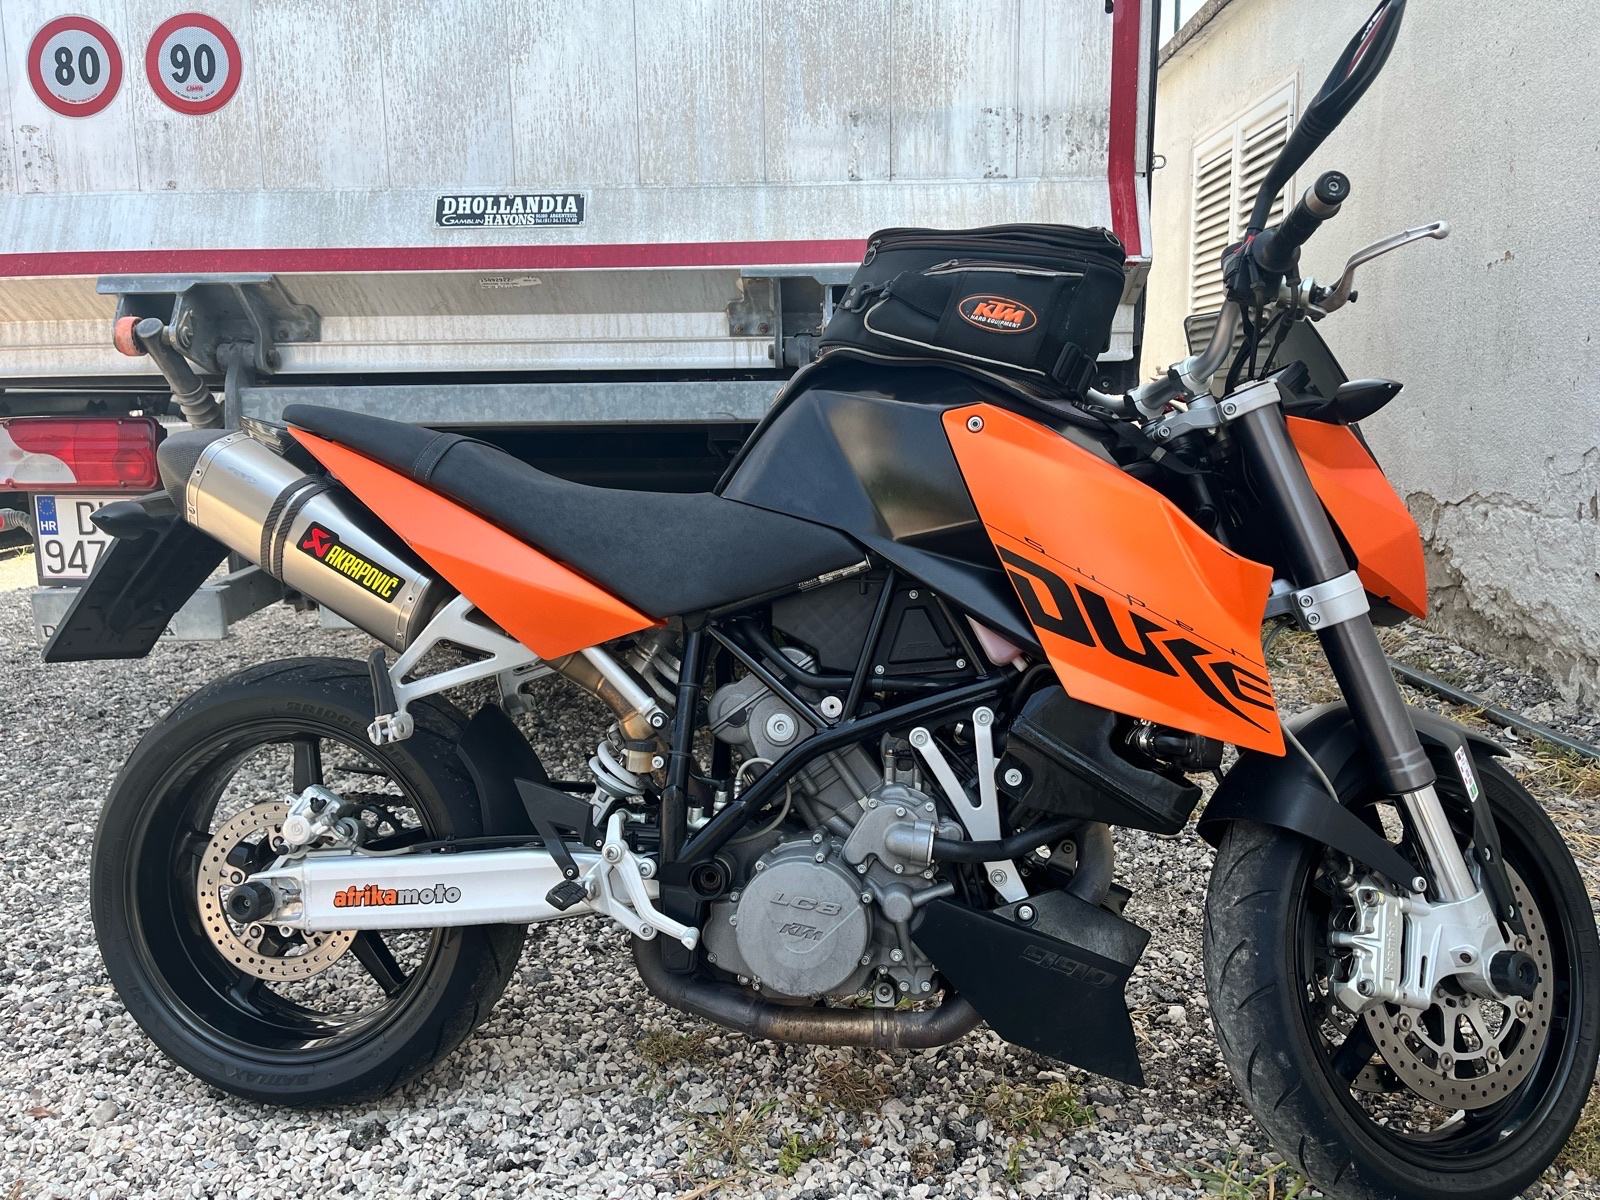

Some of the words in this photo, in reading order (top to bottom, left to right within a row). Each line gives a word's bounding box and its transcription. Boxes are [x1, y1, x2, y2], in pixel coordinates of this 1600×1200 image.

[54, 46, 100, 86] 80
[170, 43, 216, 84] 90
[442, 196, 578, 214] DHOLLANDIA
[484, 214, 535, 225] HAYONS
[970, 314, 987, 322] HARD
[987, 317, 1021, 328] EQUIPMENT
[973, 301, 1026, 324] KTM
[40, 521, 57, 531] HR
[45, 539, 106, 574] 947
[324, 545, 399, 598] AKRAPOVIČ
[995, 543, 1275, 734] DUKE
[333, 883, 462, 908] afrikamoto
[770, 891, 842, 917] LC8
[779, 922, 824, 941] KTM
[1019, 944, 1118, 989] 990
